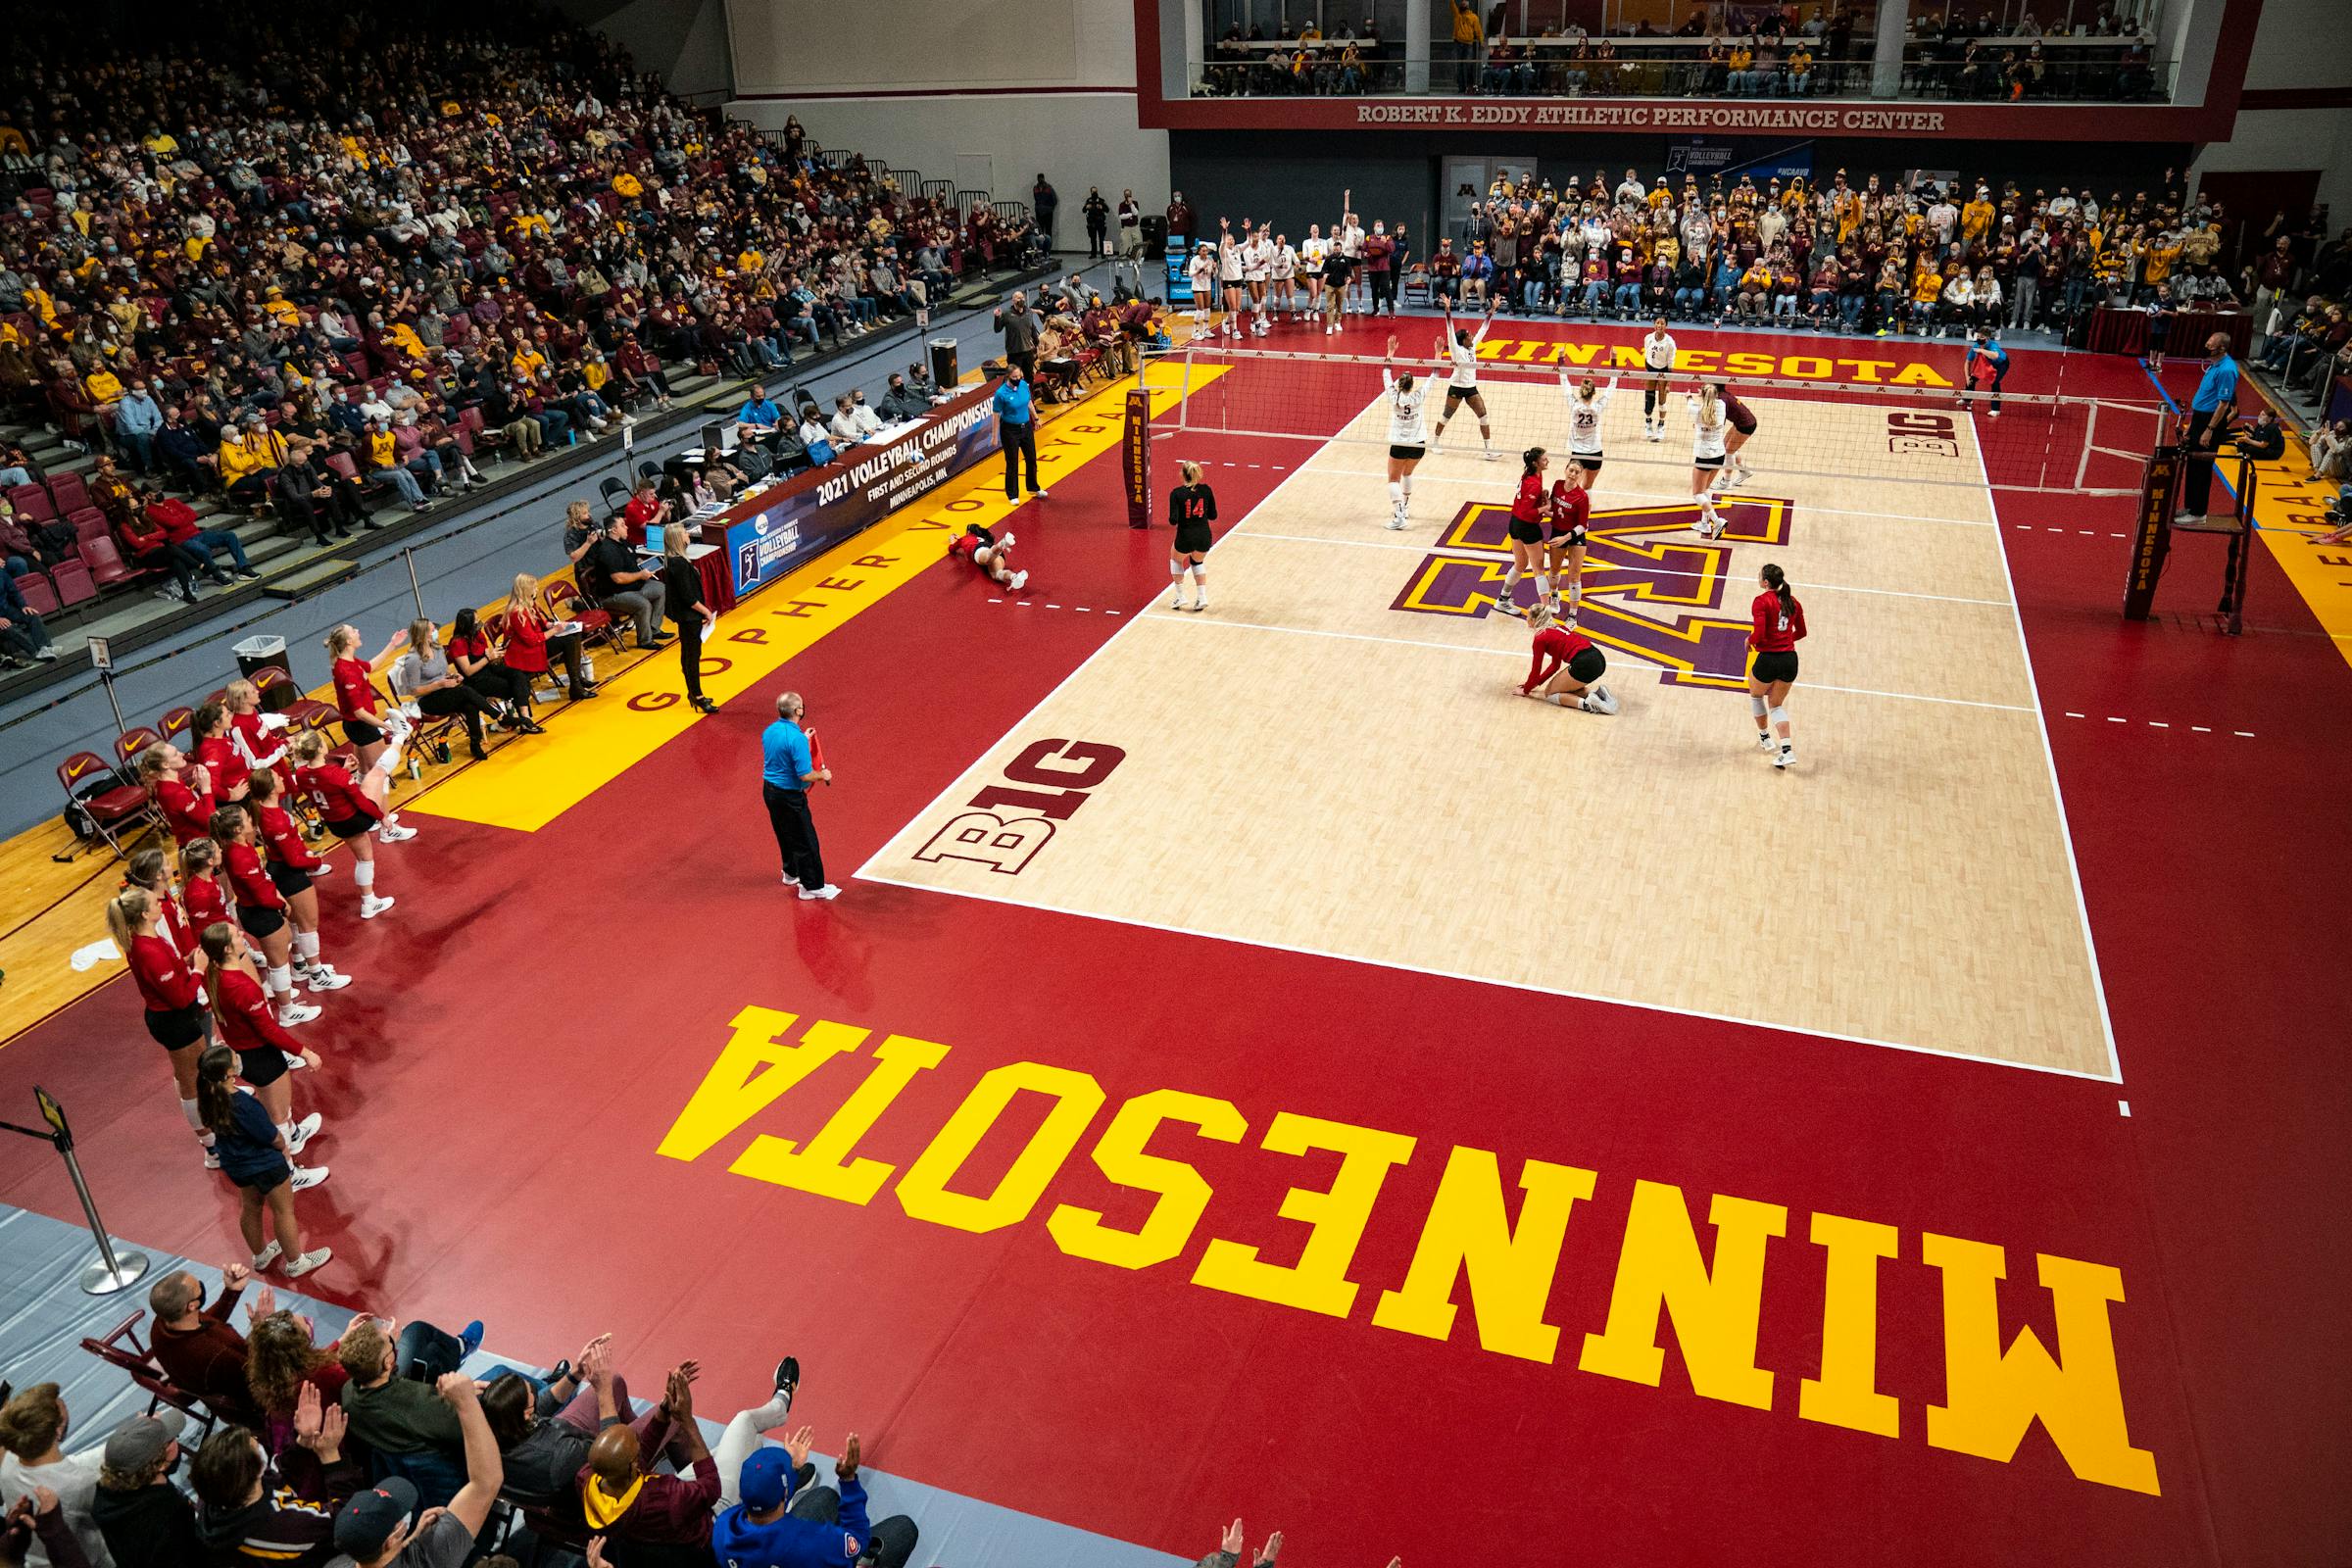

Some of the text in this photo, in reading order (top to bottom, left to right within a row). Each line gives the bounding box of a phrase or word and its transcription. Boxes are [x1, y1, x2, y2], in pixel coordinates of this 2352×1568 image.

[1357, 106, 1944, 131] ROBERT K. EDDY ATHLETIC PERFORMANCE CENTER
[1442, 339, 1953, 387] MINNESOTA
[1403, 404, 1411, 415] 5
[1578, 413, 1593, 424] 23
[815, 474, 849, 507] 2021
[850, 435, 920, 489] VOLLEYBALL
[867, 445, 957, 502] FIRST AND SECOND ROUNDS
[909, 391, 1165, 531] VOEYBA
[1132, 416, 1143, 504] MINNESOTA
[889, 467, 948, 509] MINNEAPOLIS, MN
[1185, 498, 1204, 518] 14
[760, 525, 799, 557] VOLLEYBALL
[760, 541, 797, 567] CHAMPIONSHIP
[2136, 489, 2165, 590] MINNESOTA
[626, 555, 901, 711] GOPHER
[312, 790, 330, 809] 9
[656, 1004, 2161, 1496] MINNESOTA
